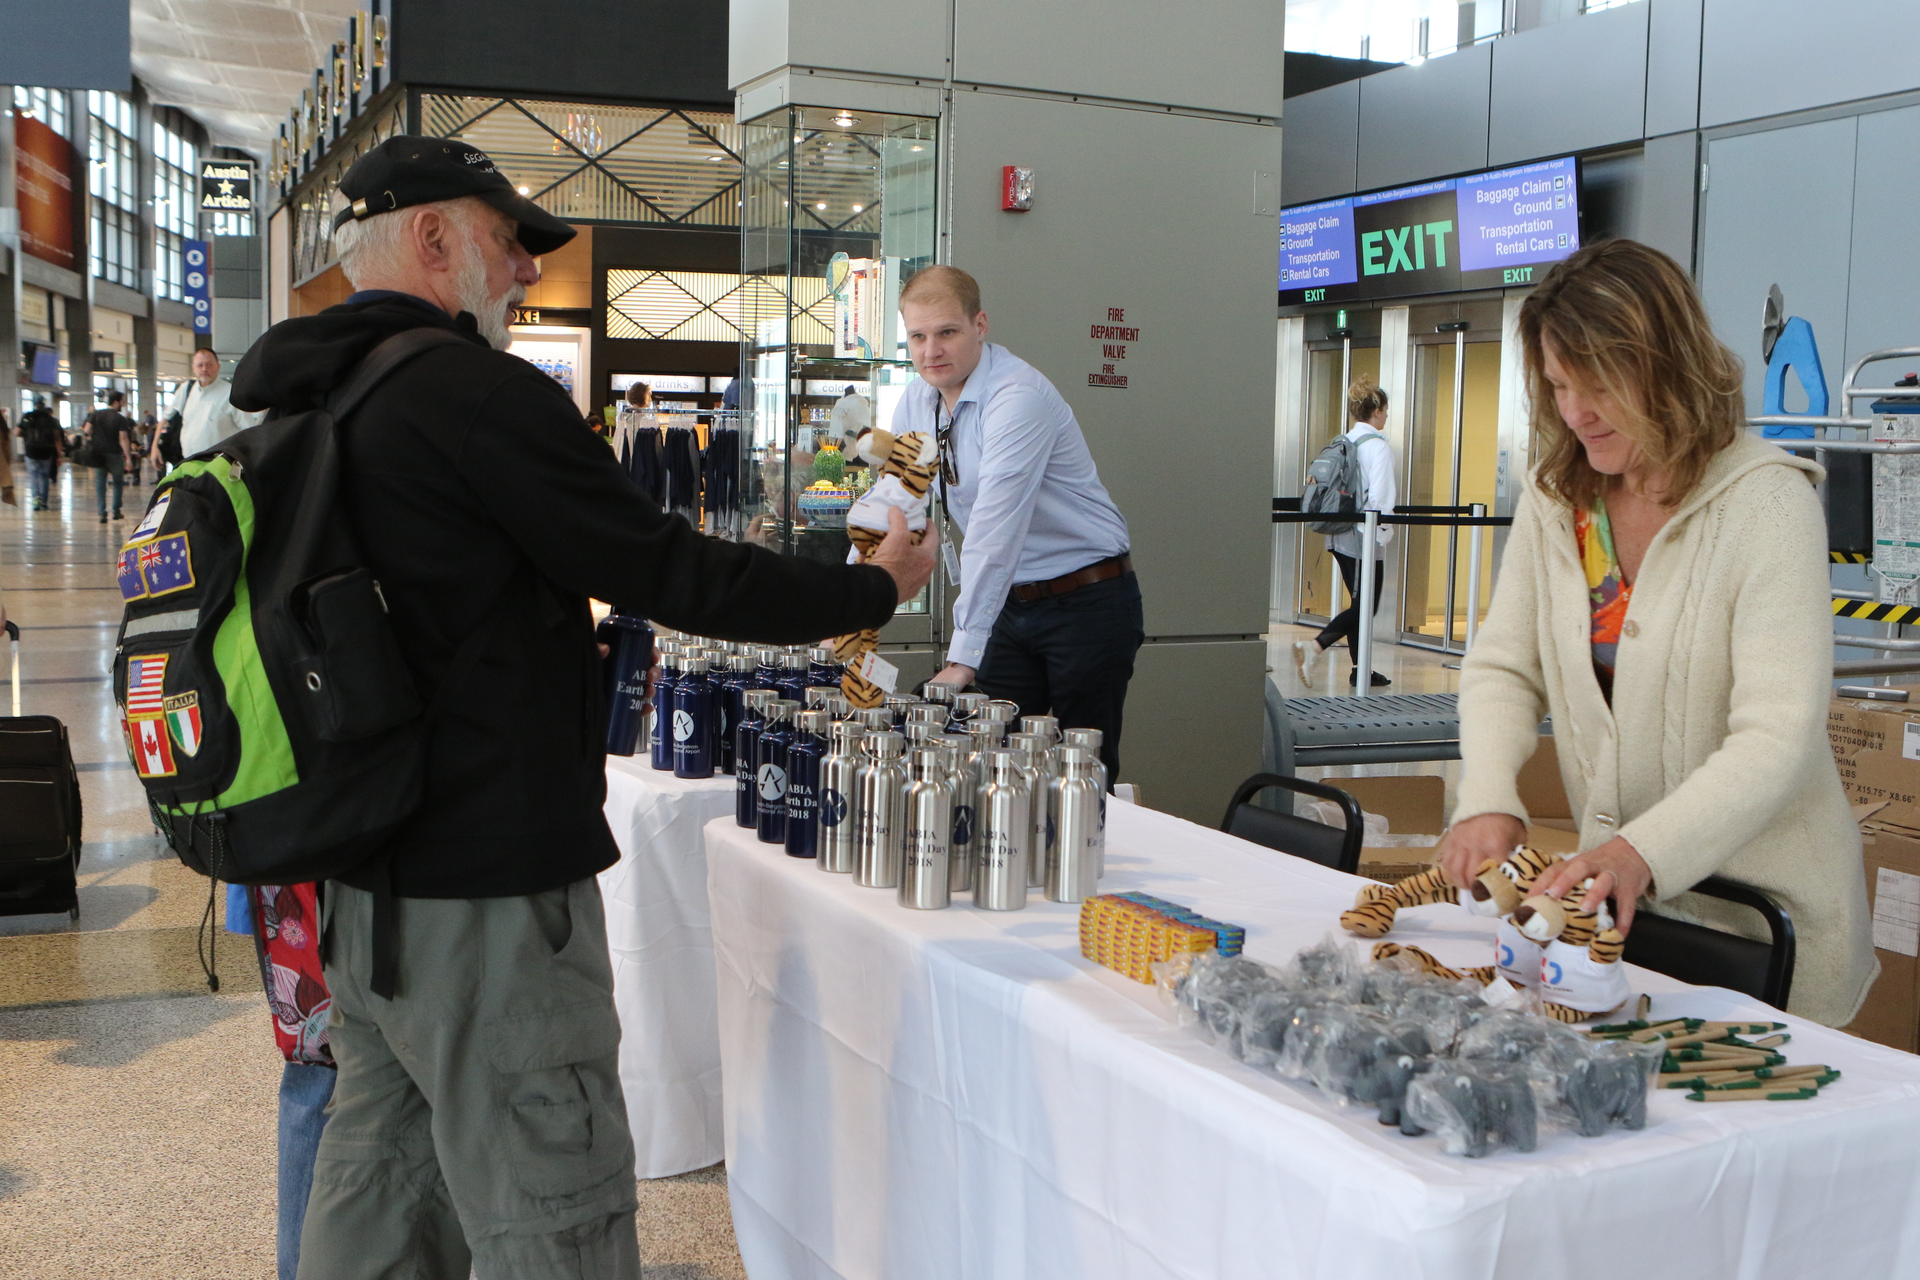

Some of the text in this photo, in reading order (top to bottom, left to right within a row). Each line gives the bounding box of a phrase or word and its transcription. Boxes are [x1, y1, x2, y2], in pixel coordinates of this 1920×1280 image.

[463, 152, 491, 165] SEGA
[202, 164, 249, 180] Austin
[1465, 176, 1483, 184] Welcome
[1523, 163, 1549, 174] International
[1549, 160, 1564, 169] Airport
[1361, 195, 1377, 203] Welcome
[1411, 184, 1434, 194] International
[1433, 182, 1447, 190] Airport
[1476, 180, 1552, 204] Baggage Claim
[201, 193, 251, 209] Article
[1513, 199, 1552, 216] Ground
[1286, 216, 1340, 236] Baggage Claim
[1480, 219, 1553, 240] Transportation
[1287, 235, 1314, 251] Ground
[1361, 220, 1453, 276] EXIT
[1496, 238, 1554, 256] Rental Cars
[1288, 248, 1340, 266] Transportation
[1289, 266, 1330, 281] Rental Cars
[1503, 267, 1533, 284] EXIT
[1304, 288, 1326, 303] EXIT
[1107, 307, 1125, 322] FIRE
[1090, 324, 1140, 342] DEPARTMENT
[1103, 344, 1126, 360] VALVE
[1102, 363, 1115, 375] FIRE
[655, 379, 690, 389] drinks
[1088, 373, 1128, 386] EXTINGUISHER
[822, 383, 844, 393] cold
[632, 669, 647, 681] AB
[616, 681, 645, 697] Earth
[166, 694, 196, 710] ITALIA
[629, 698, 643, 711] 201
[1829, 712, 1845, 722] LUE
[742, 771, 757, 783] Day
[1840, 768, 1857, 779] LBS
[788, 783, 813, 795] ABIA
[803, 798, 818, 808] Da
[788, 808, 810, 820] 2018
[927, 843, 947, 856] Day
[998, 845, 1018, 858] Day
[907, 856, 933, 868] 2018
[980, 855, 1004, 868] 2018
